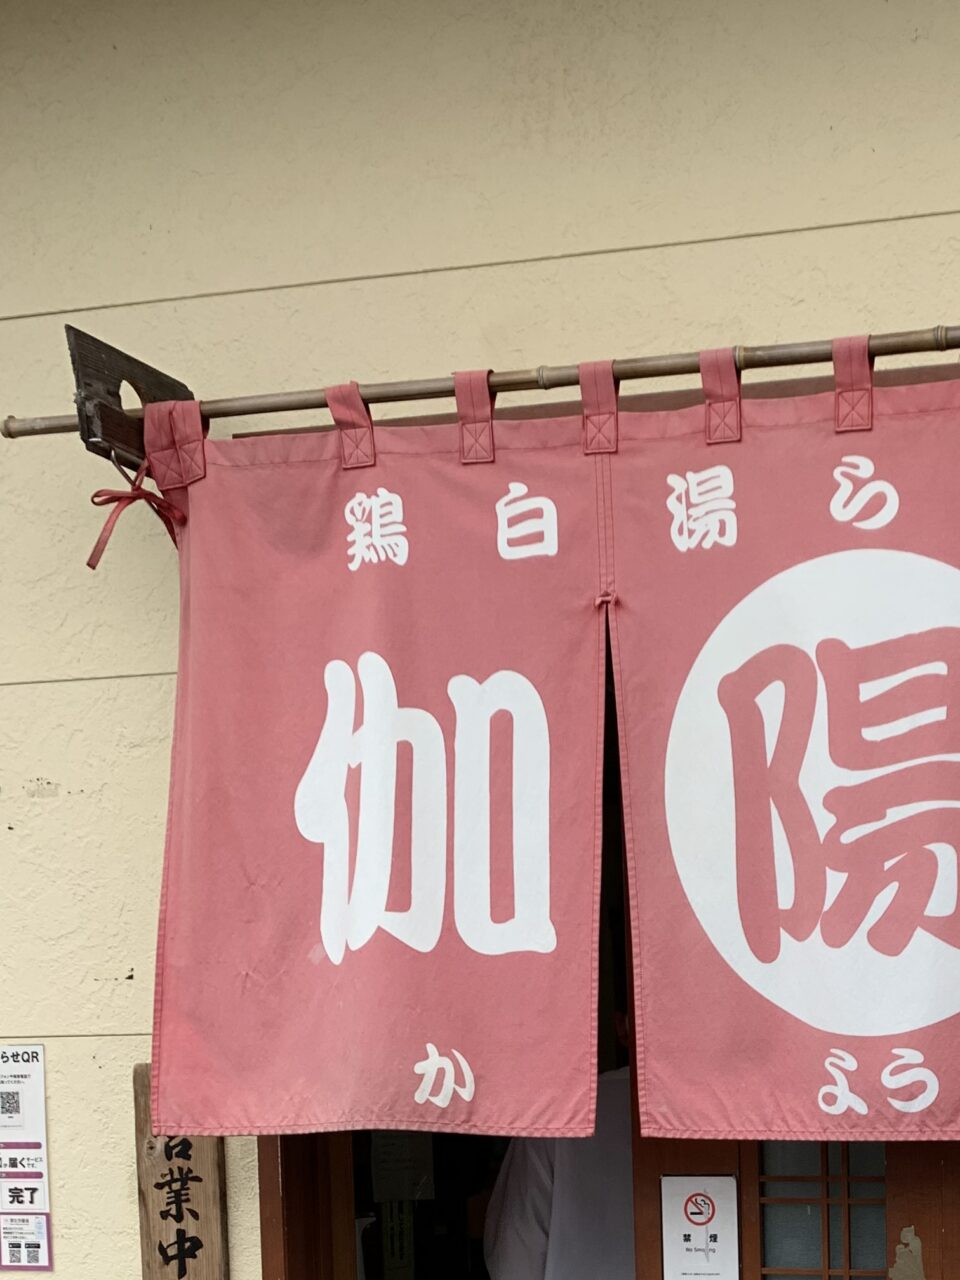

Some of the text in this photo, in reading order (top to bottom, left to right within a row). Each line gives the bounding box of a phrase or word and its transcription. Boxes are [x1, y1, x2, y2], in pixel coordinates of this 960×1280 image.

[413, 1042, 475, 1109] か
[817, 1046, 940, 1116] よう
[8, 1186, 39, 1204] 完了
